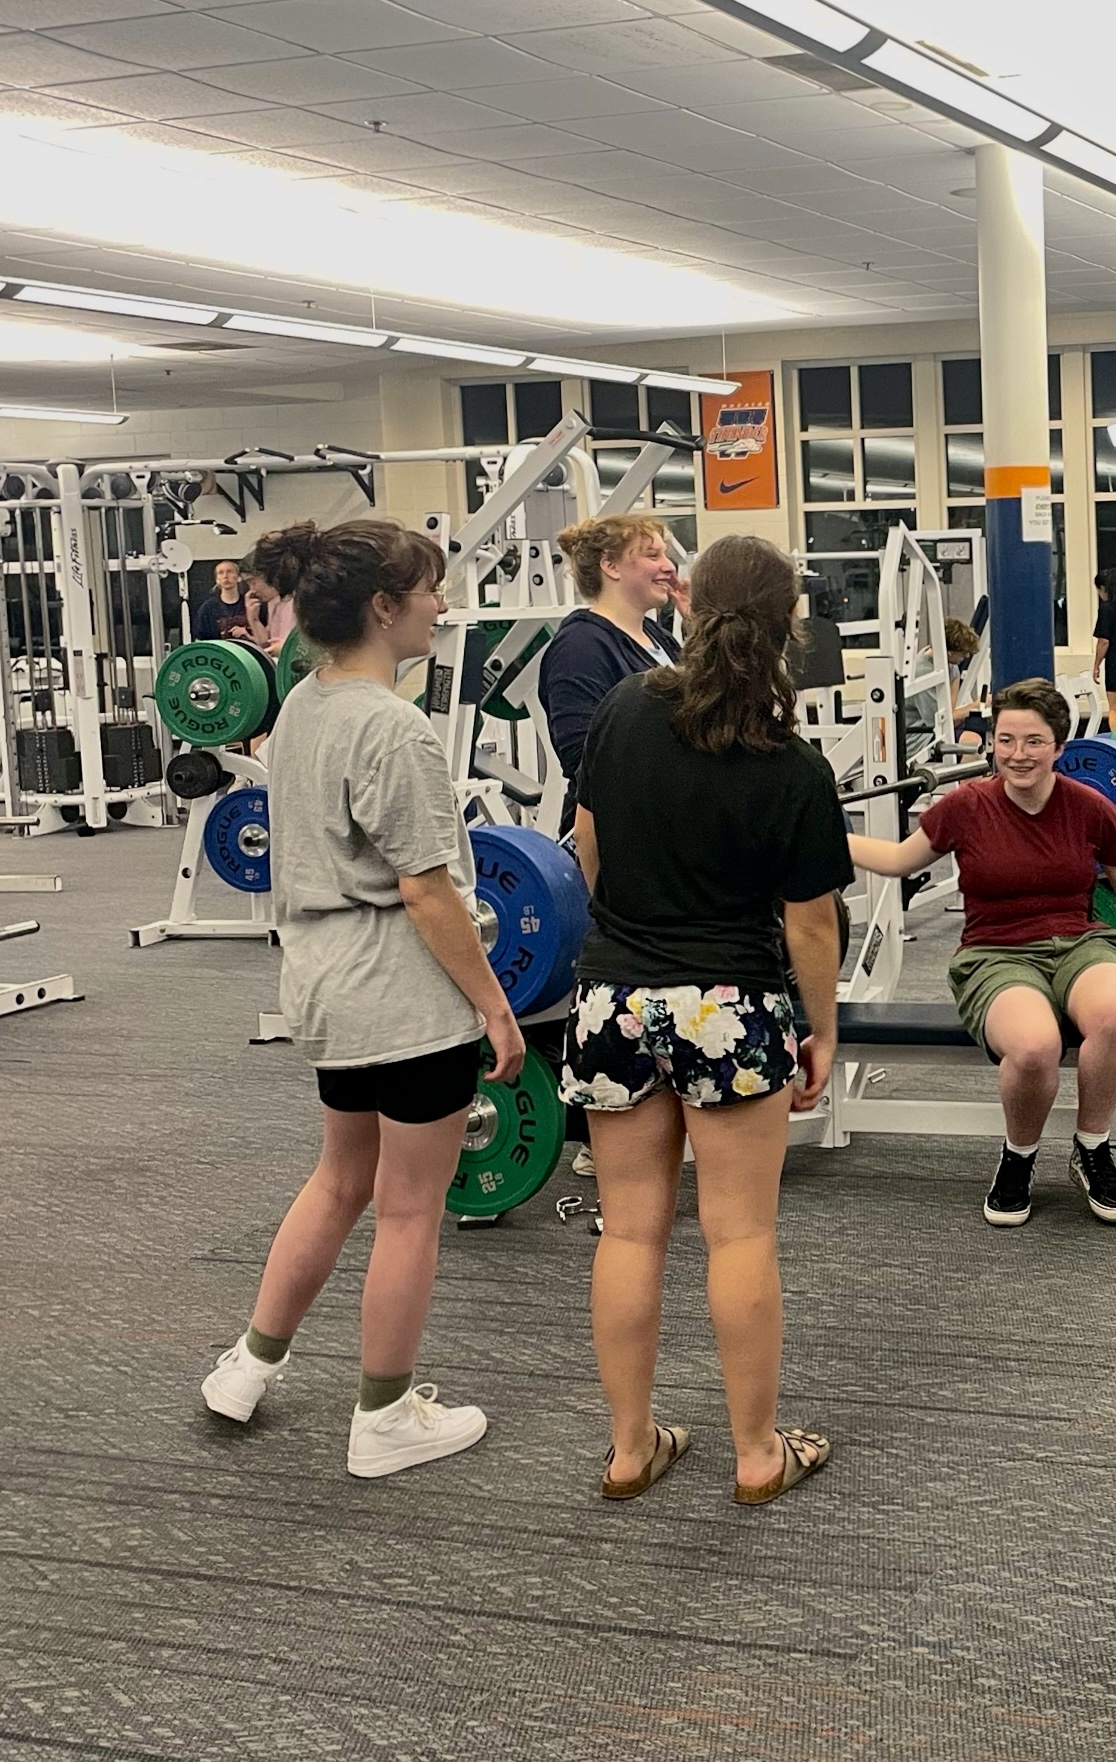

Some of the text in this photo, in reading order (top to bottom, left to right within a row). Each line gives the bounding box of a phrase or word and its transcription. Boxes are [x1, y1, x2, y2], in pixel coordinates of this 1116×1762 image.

[181, 655, 242, 693] ROGUE
[168, 697, 229, 734] ROGUE
[217, 805, 242, 873] ROGUE
[520, 916, 541, 935] 45
[477, 1170, 497, 1195] 25
